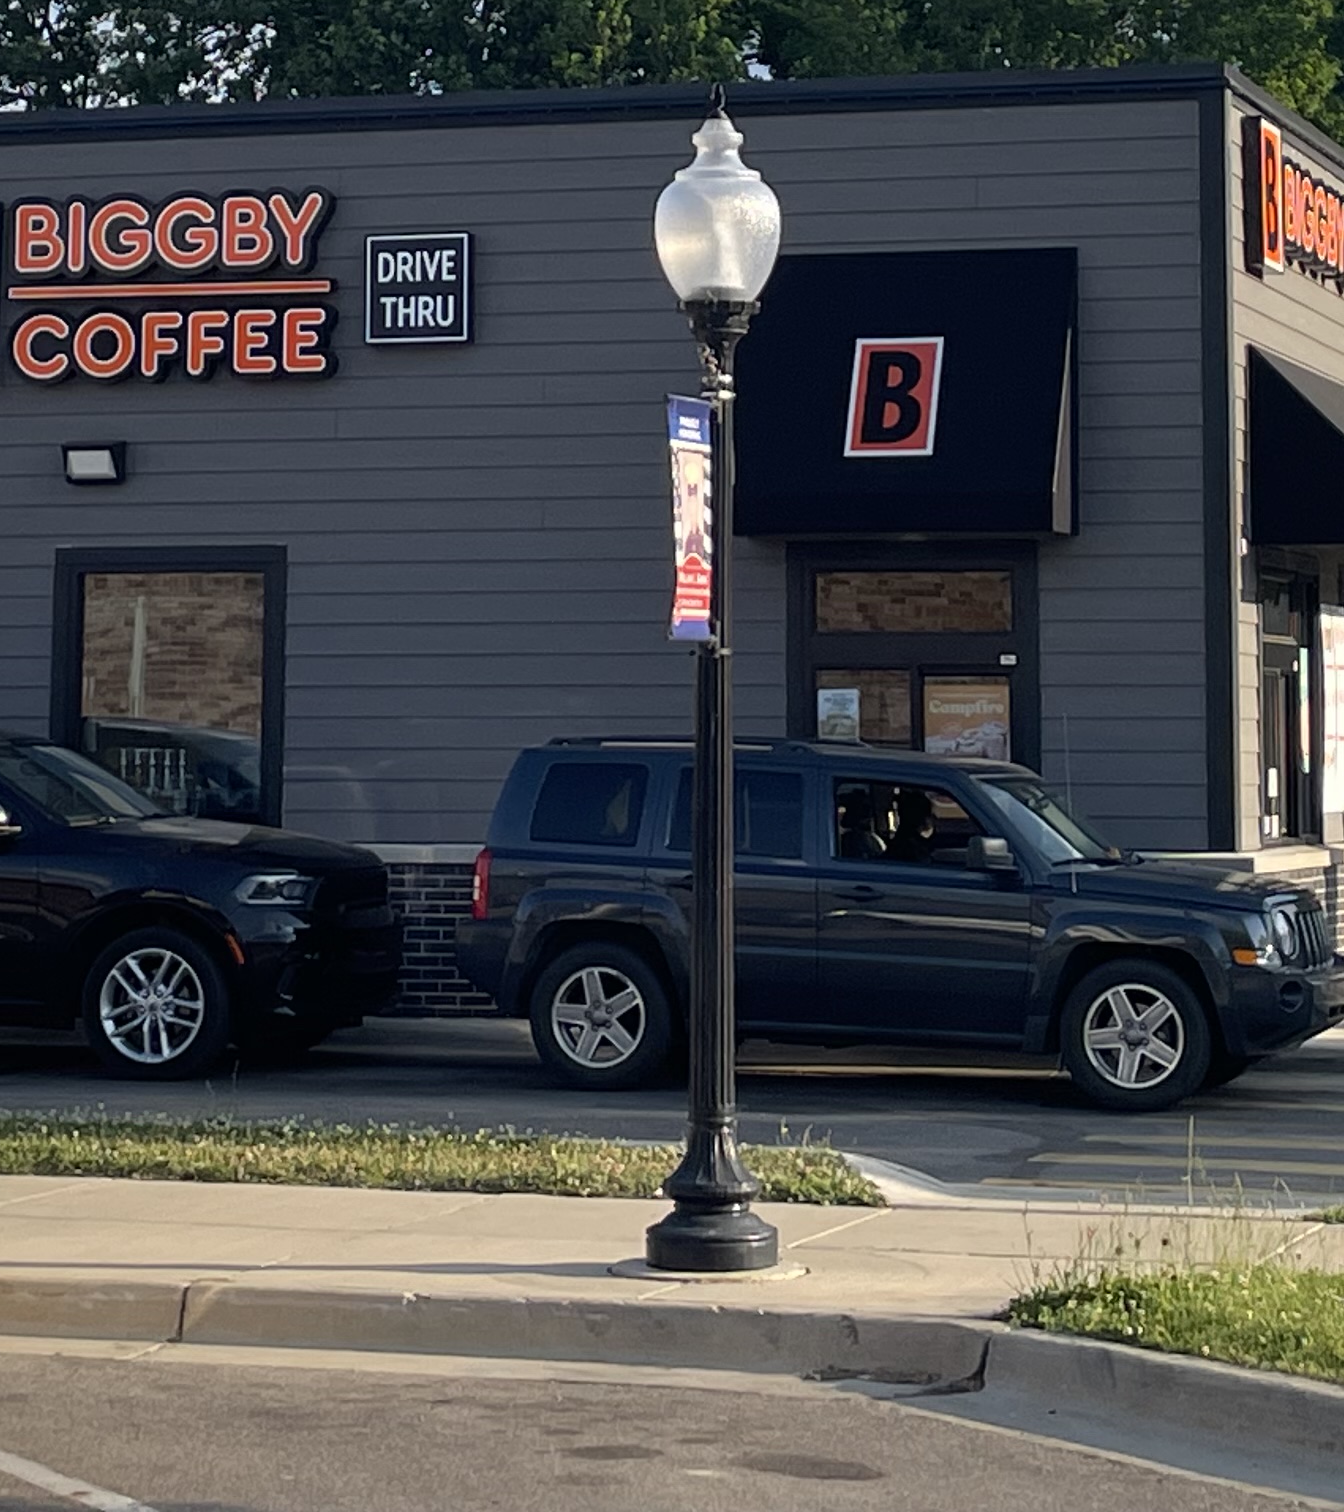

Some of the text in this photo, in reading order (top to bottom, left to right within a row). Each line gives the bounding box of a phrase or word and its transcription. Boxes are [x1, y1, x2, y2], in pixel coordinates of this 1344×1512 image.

[14, 192, 324, 273] BIGGBY
[377, 249, 456, 283] DRIVE
[380, 294, 454, 328] THRU
[12, 308, 326, 379] COFFEE
[861, 351, 921, 443] B
[929, 699, 1004, 717] Campfire
